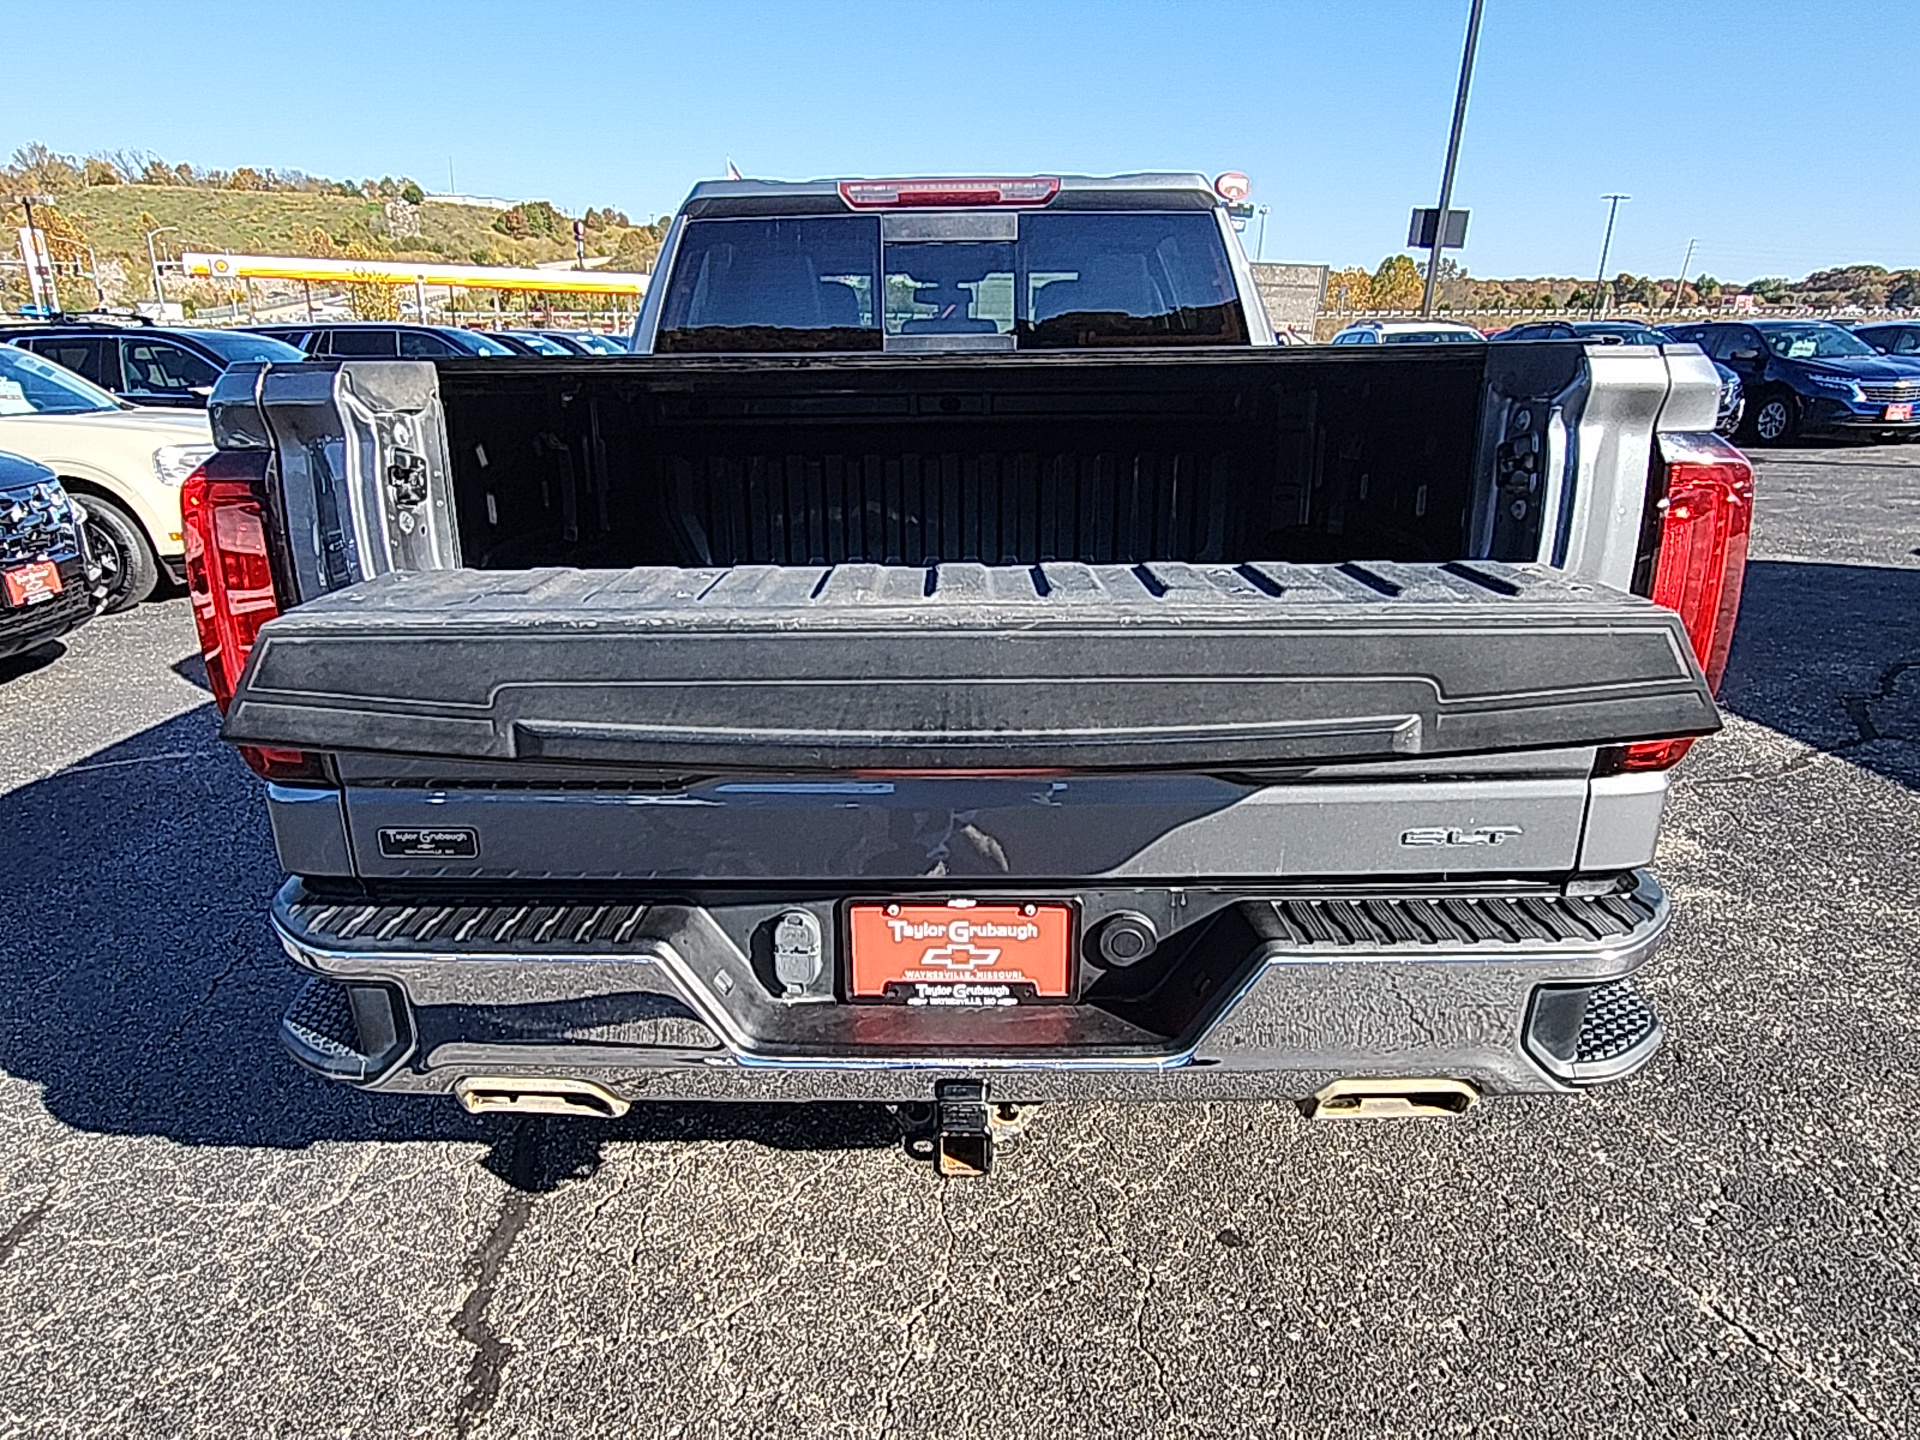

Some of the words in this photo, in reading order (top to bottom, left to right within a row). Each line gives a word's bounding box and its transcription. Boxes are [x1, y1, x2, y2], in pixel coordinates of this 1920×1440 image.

[386, 830, 418, 843] Taylor
[419, 830, 468, 843] Grubaugh
[888, 920, 947, 942] Taylor
[948, 920, 1038, 942] Grubaugh
[915, 984, 952, 998] Taylor
[953, 984, 1010, 998] Grubaugh
